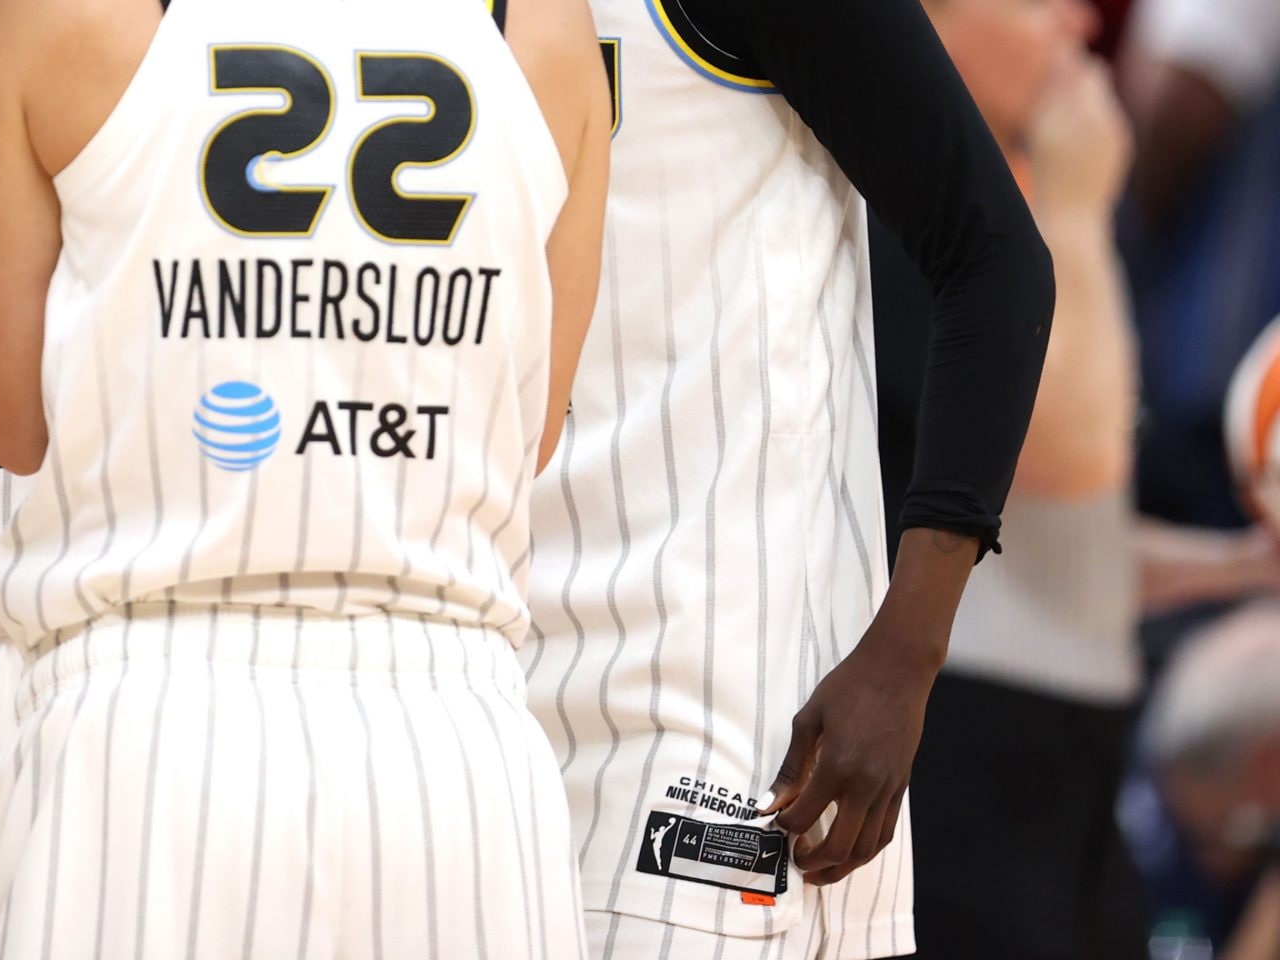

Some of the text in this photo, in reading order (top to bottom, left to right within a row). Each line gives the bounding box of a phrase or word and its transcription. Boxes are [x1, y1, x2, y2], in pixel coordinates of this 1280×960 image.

[198, 43, 477, 246] 22
[153, 258, 502, 346] VANDERSLOOT
[295, 400, 450, 460] AT&T
[665, 785, 697, 805] NIKE
[682, 833, 697, 846] 44
